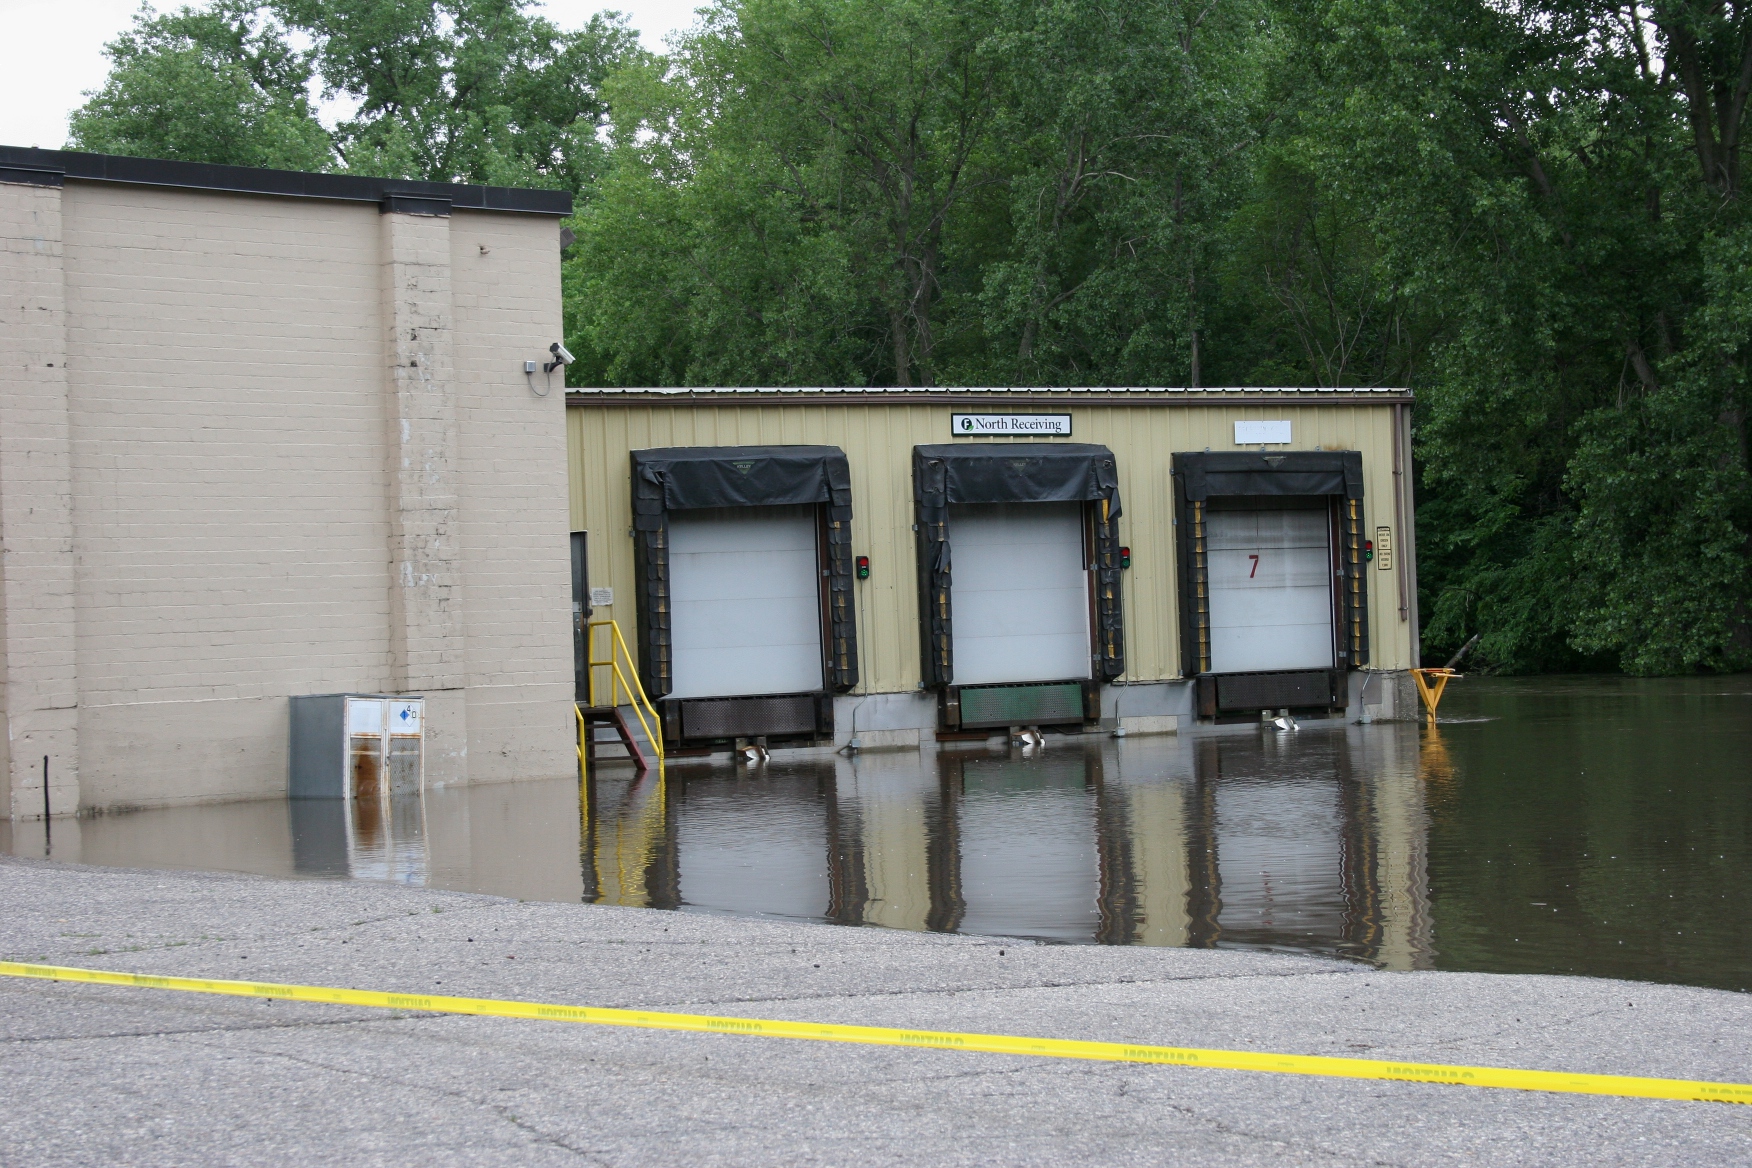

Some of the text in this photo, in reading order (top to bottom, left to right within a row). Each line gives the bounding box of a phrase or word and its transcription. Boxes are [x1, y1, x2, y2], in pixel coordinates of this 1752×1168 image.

[975, 418, 1062, 433] North Receiving
[1248, 555, 1259, 578] 7
